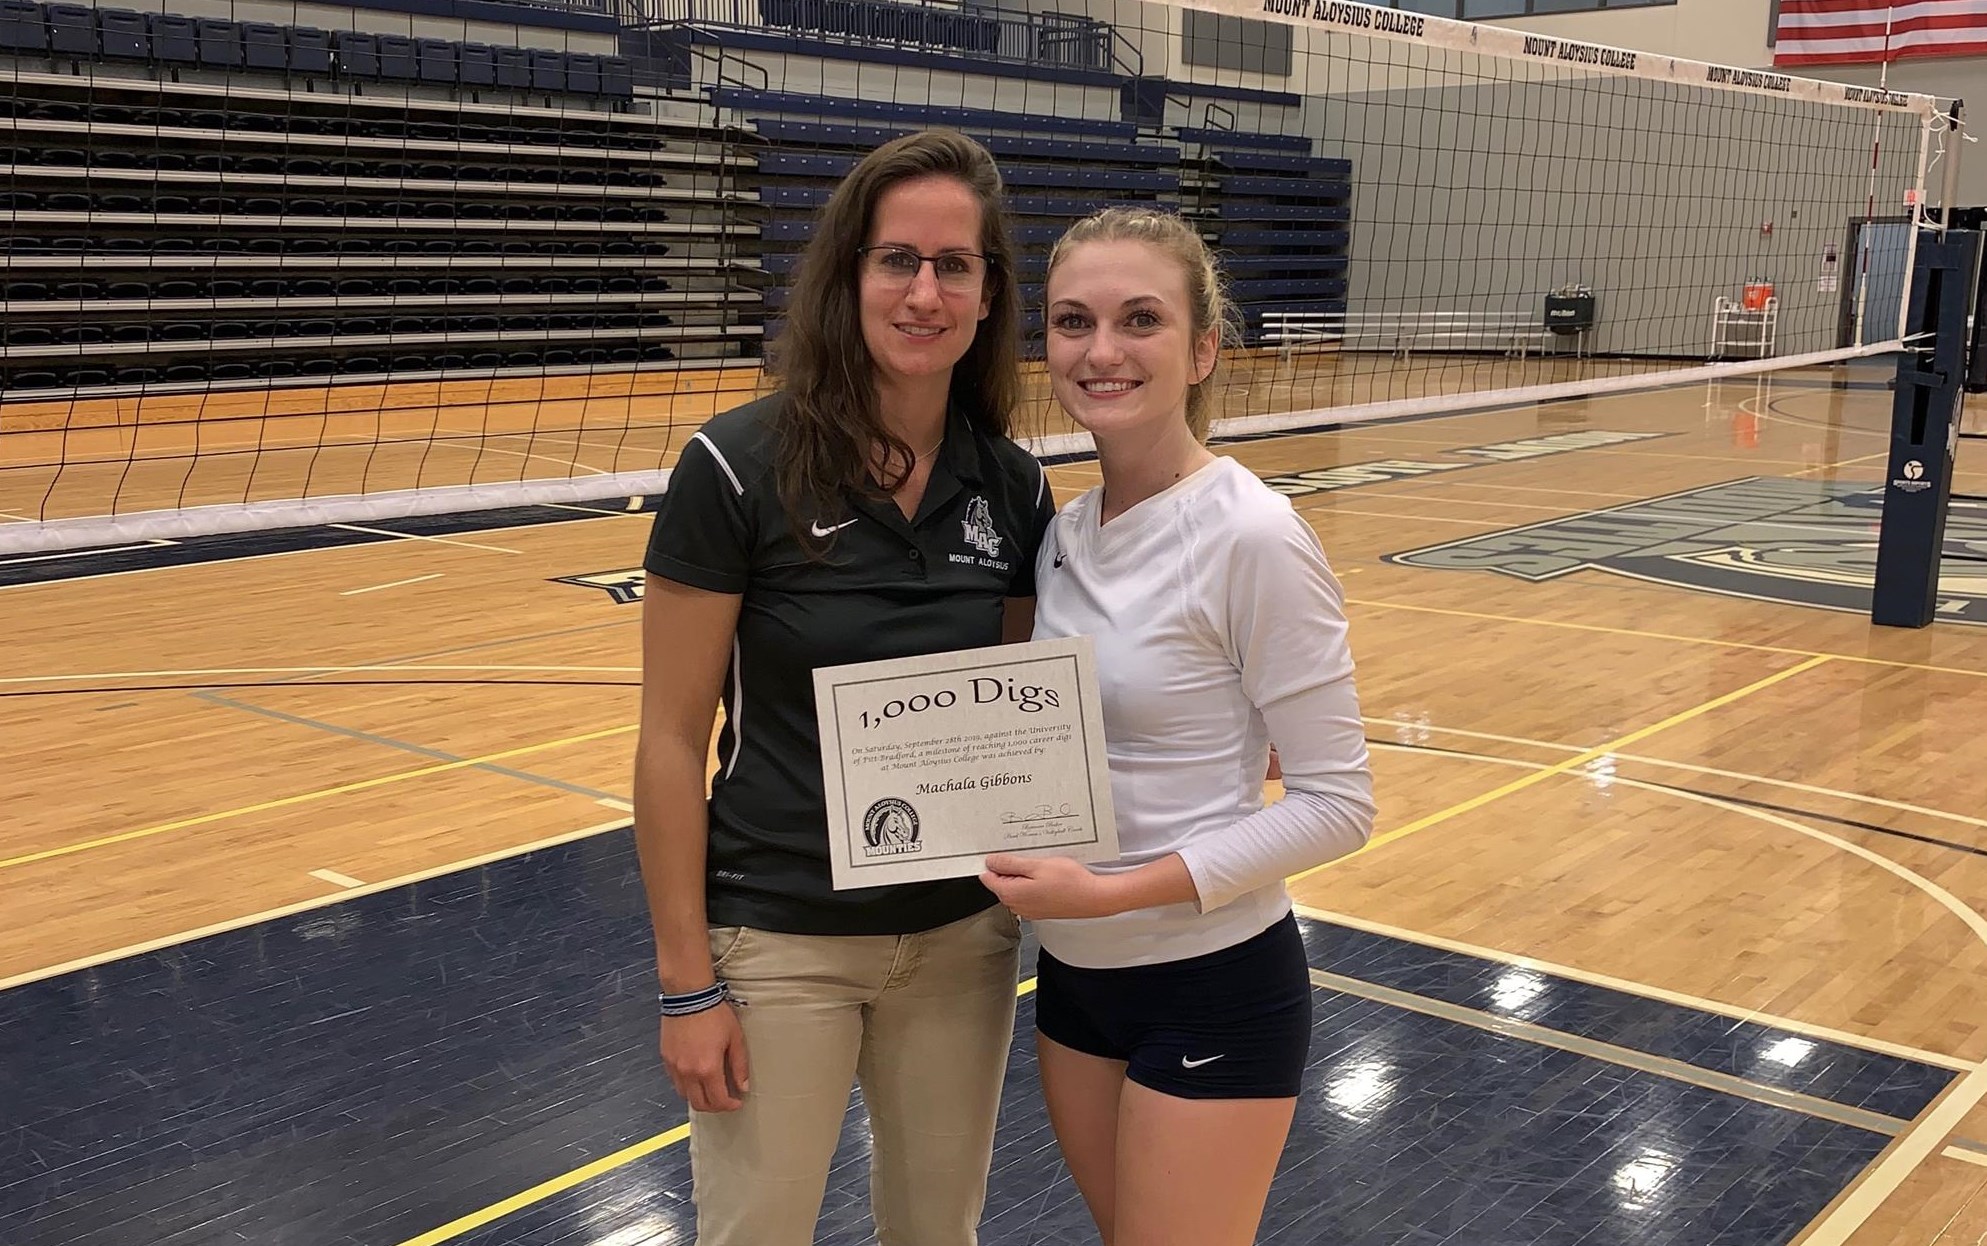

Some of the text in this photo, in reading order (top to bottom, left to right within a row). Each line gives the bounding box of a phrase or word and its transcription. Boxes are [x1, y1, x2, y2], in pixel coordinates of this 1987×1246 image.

[1263, 0, 1425, 37] MOUNT ALOYSIUS COLLEGE
[1523, 36, 1637, 70] MOUNT ALOYSIUS COLLEGE
[1706, 66, 1791, 92] MOUNT ALOYSIUS COLLEGE
[961, 519, 1003, 558] MAC
[948, 553, 1010, 571] MOUNT ALOYSIUS
[858, 677, 1060, 729] 1,000 Digs
[853, 756, 862, 765] of
[925, 746, 961, 757] milestone
[962, 744, 971, 753] of
[972, 740, 1006, 751] reaching
[1007, 738, 1028, 747] 1,000
[1029, 735, 1054, 744] career
[1055, 733, 1072, 743] digs
[904, 737, 943, 749] September
[984, 730, 1013, 741] against
[1014, 728, 1027, 736] the
[1029, 724, 1072, 735] University
[890, 761, 917, 771] Mount
[918, 757, 951, 769] Aloysius
[953, 753, 980, 764] College
[981, 752, 996, 760] was
[997, 748, 1033, 758] achieved
[915, 772, 1033, 795] Machala Gibbons
[863, 840, 922, 857] MOUNTIES
